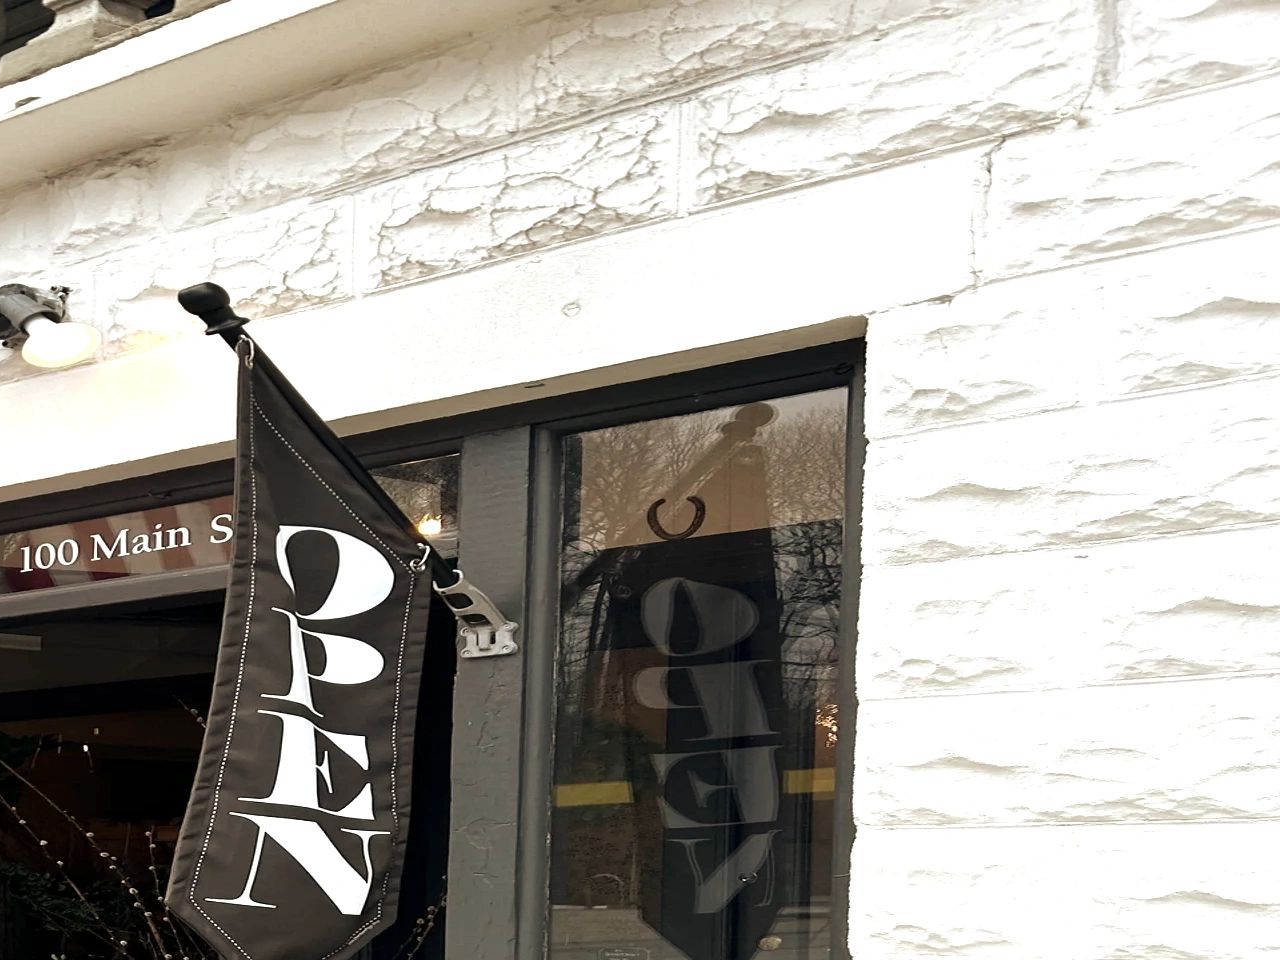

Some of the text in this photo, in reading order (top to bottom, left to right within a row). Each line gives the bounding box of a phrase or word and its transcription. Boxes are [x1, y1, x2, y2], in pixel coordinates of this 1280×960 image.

[20, 513, 235, 573] 100 Main S
[205, 524, 395, 916] OPEN
